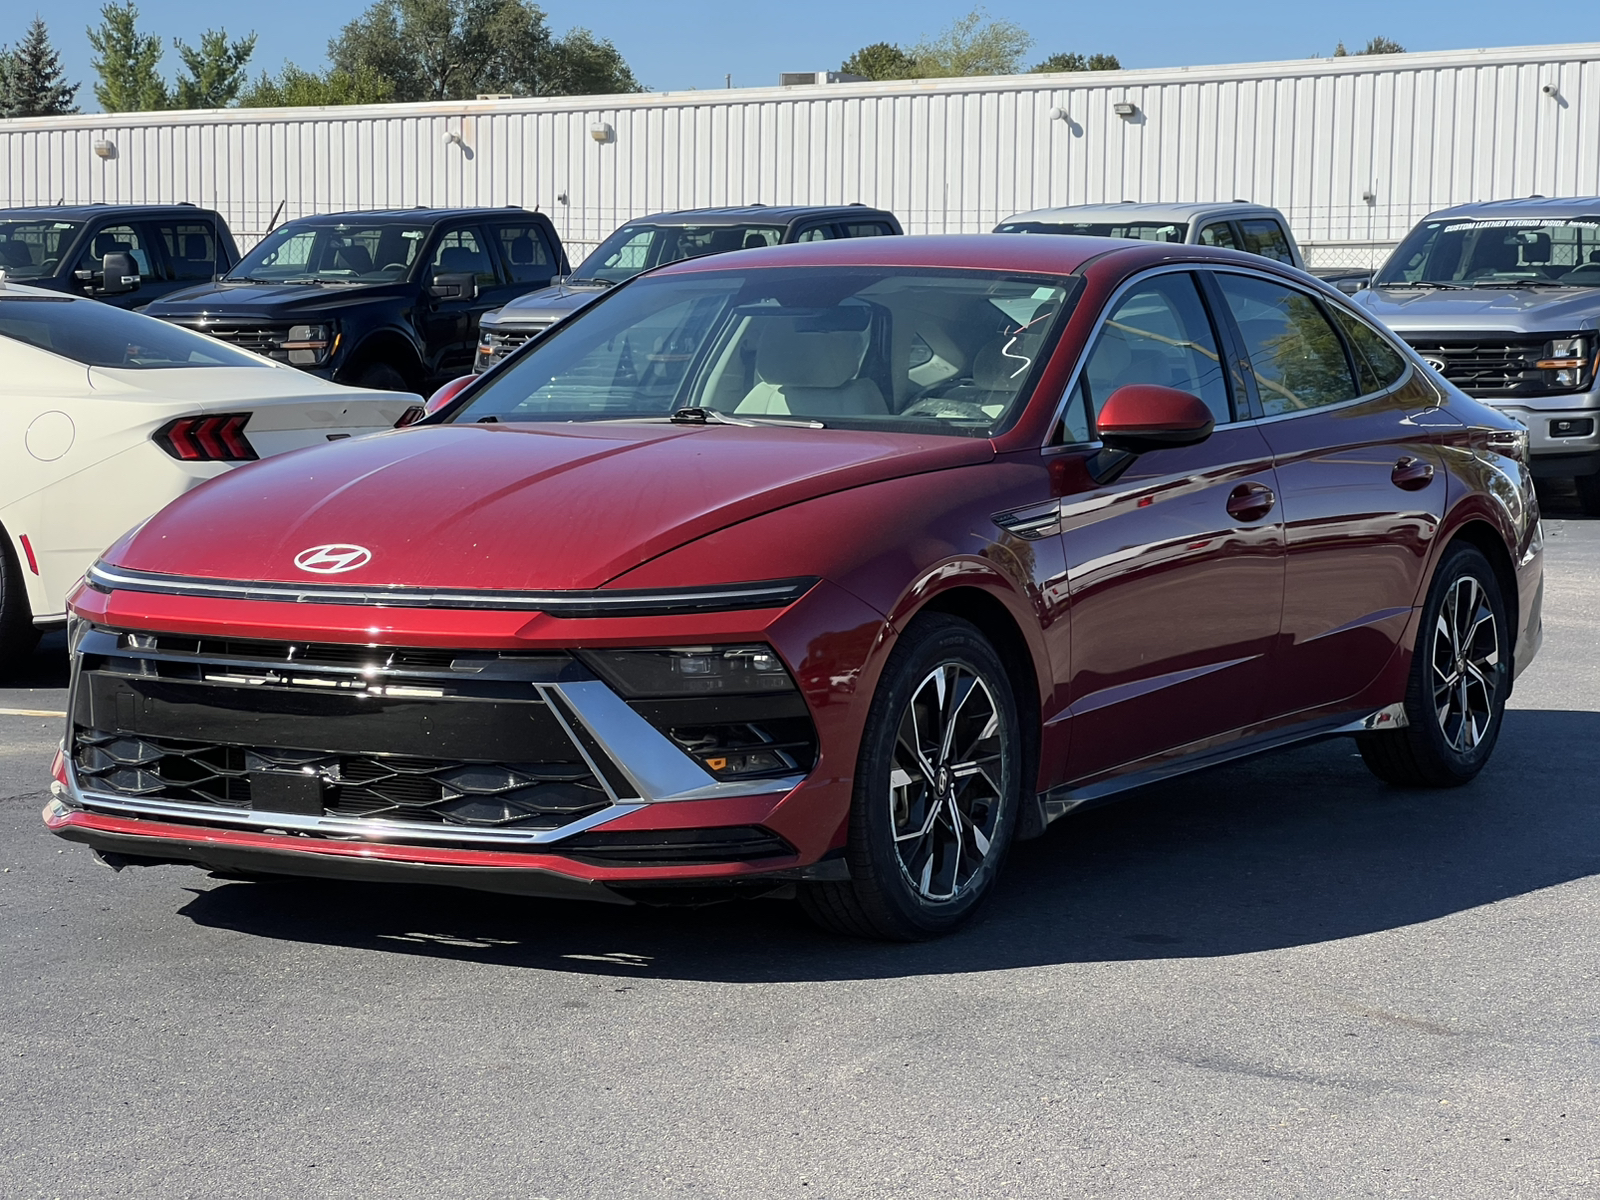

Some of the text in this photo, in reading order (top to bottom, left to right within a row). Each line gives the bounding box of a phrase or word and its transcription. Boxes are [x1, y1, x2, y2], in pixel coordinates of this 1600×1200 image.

[1444, 219, 1567, 233] CUSTOM LEATHER INTERIOR INSIDE
